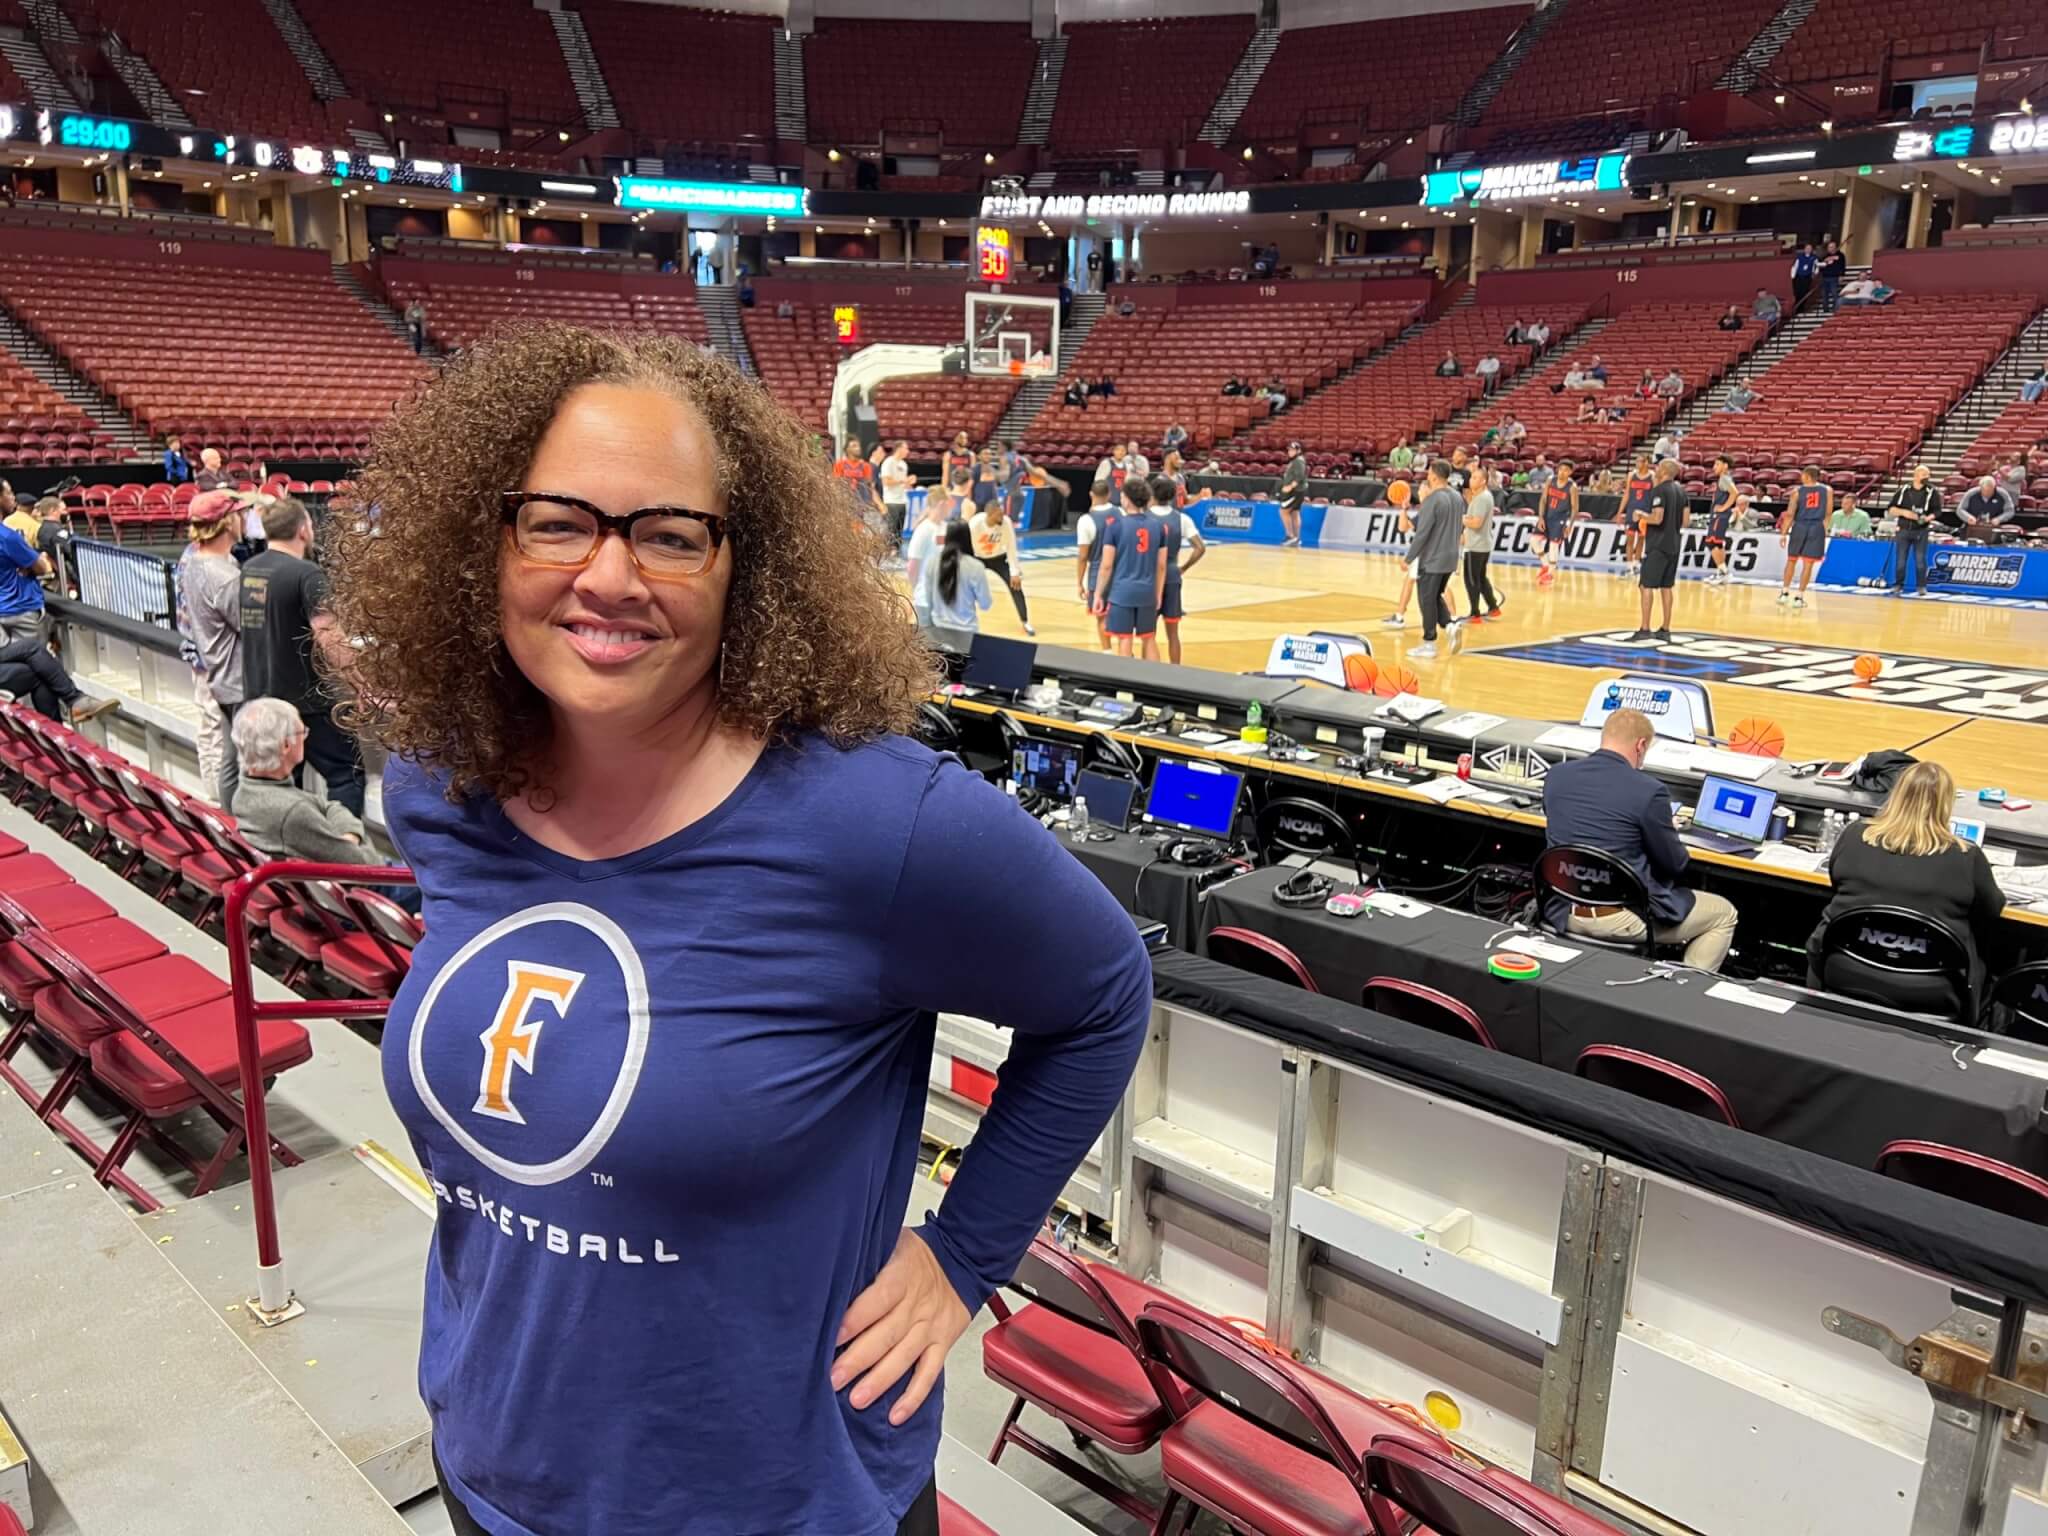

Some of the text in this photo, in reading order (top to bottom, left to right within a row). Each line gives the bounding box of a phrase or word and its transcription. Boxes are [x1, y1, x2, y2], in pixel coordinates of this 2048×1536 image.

[60, 115, 131, 150] 29:00
[1042, 194, 1085, 217] AND
[1086, 192, 1166, 216] SECOND
[1168, 190, 1251, 214] ROUNDS
[158, 241, 182, 255] 119
[981, 247, 1005, 275] 30
[1616, 270, 1638, 283] 115
[1806, 492, 1820, 507] 21
[1136, 527, 1149, 553] 3
[1491, 521, 1601, 558] ECND
[1948, 554, 1999, 569] MARCH
[1951, 567, 2018, 585] MADNESS
[1618, 686, 1653, 701] MARCH
[1620, 698, 1669, 713] MADNESS
[1279, 815, 1325, 837] NCAA
[1558, 860, 1611, 885] NCAA
[1858, 927, 1928, 954] NCAA
[472, 959, 586, 1126] F
[591, 1172, 613, 1188] TM
